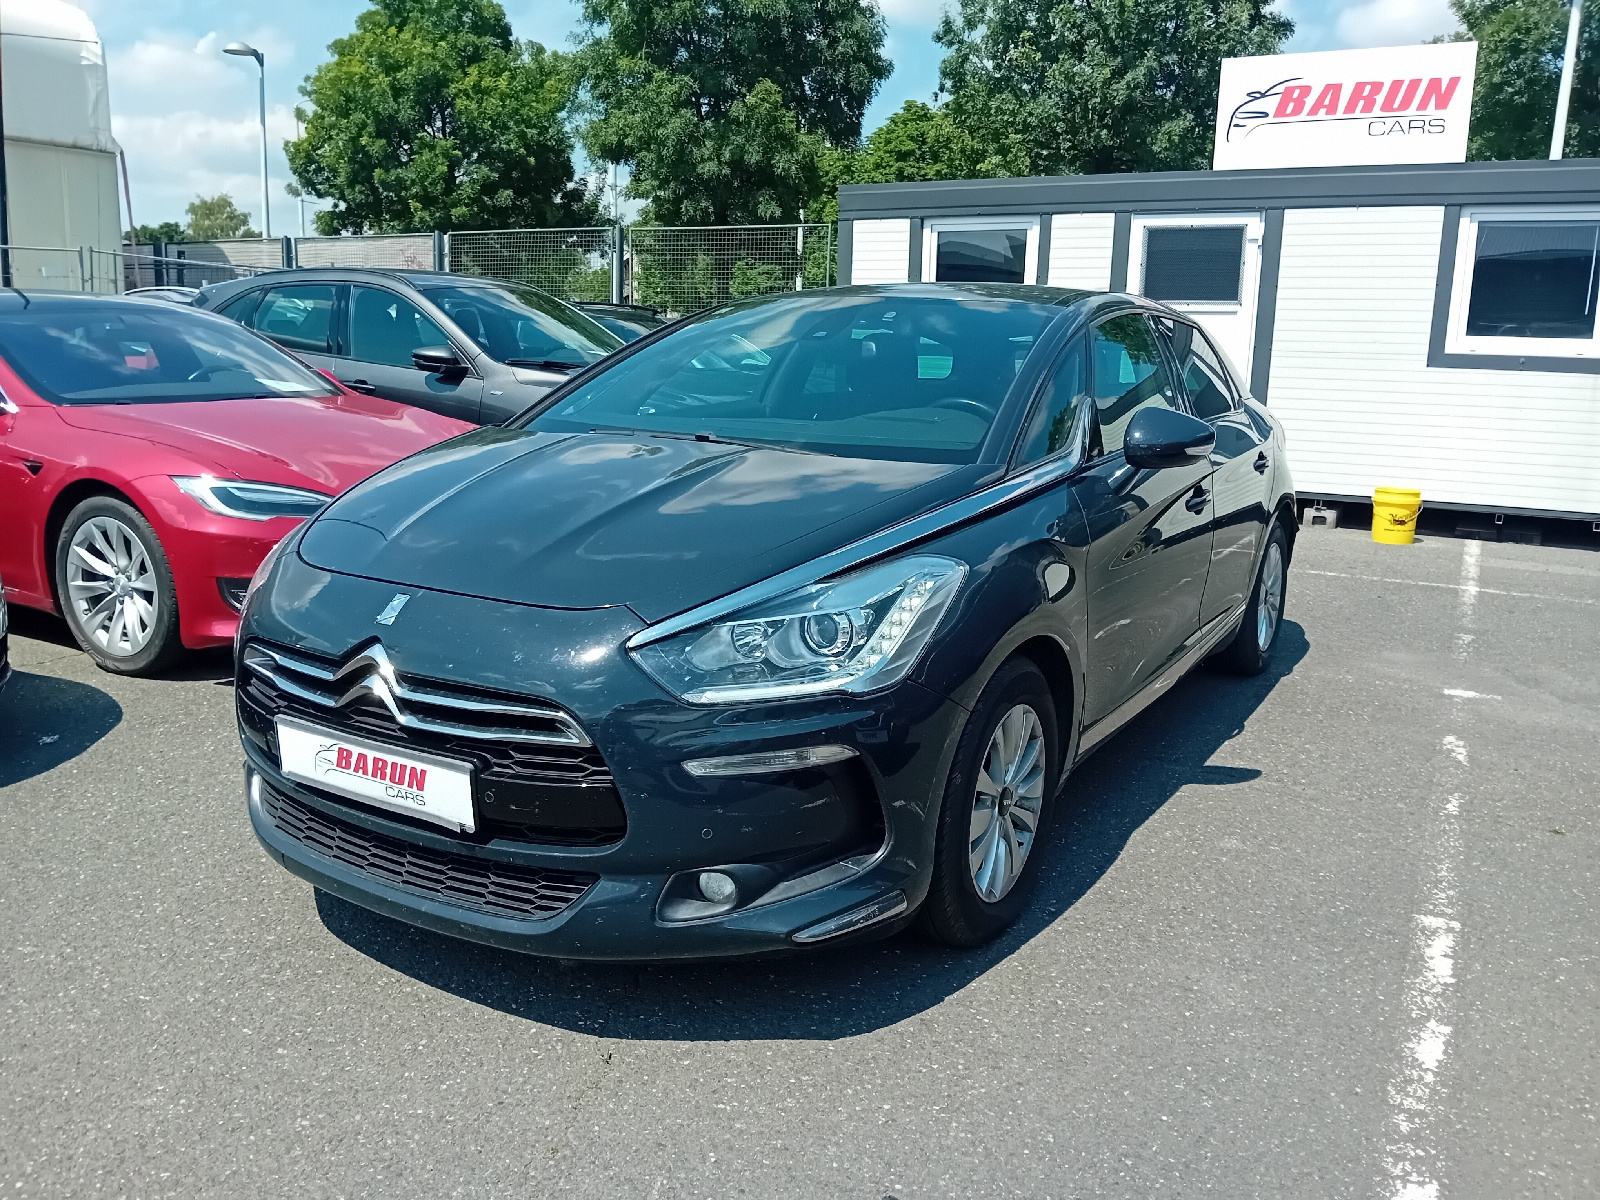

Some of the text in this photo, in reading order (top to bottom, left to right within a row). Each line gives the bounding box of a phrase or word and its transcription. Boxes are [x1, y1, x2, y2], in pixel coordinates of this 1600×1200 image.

[1273, 76, 1461, 118] BARUN
[1368, 119, 1446, 136] CARS
[336, 747, 427, 791] BARUN
[385, 785, 426, 806] CARS
